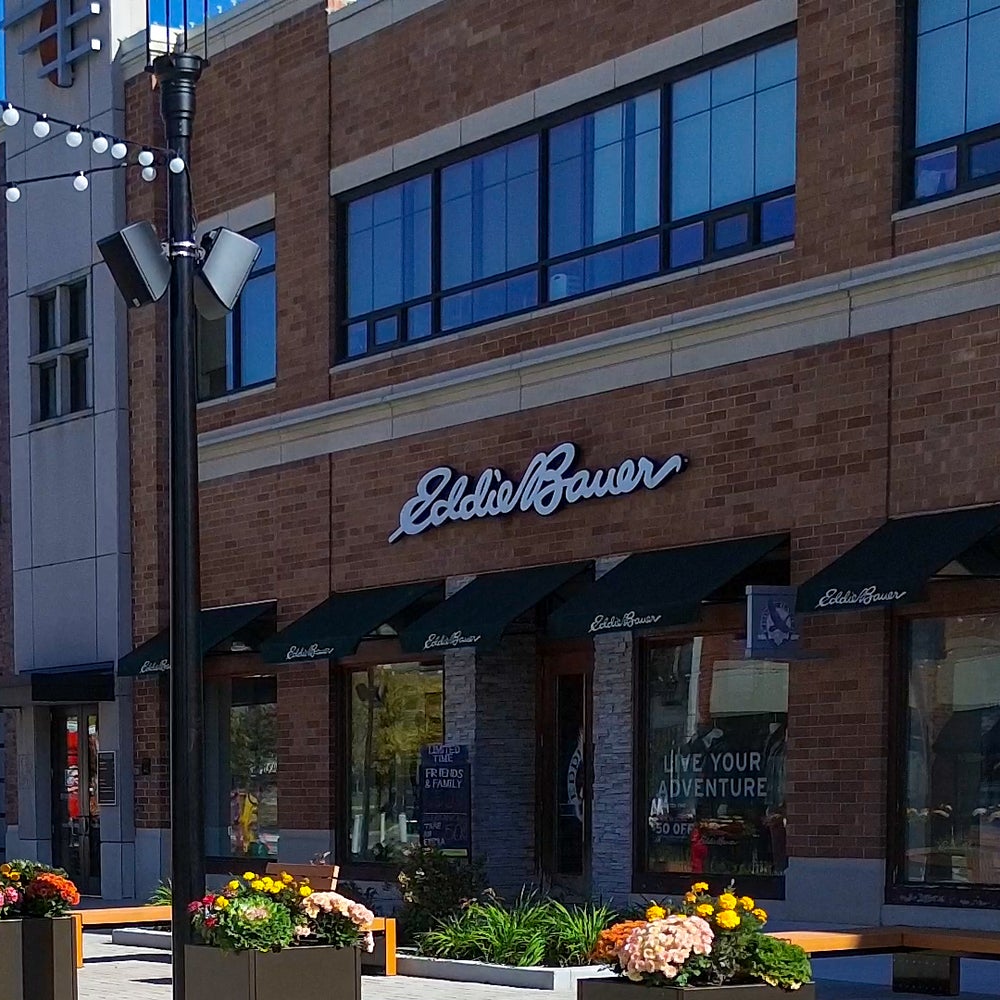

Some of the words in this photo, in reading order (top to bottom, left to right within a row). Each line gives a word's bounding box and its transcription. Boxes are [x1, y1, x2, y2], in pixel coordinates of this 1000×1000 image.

[388, 465, 521, 544] Eddie
[520, 442, 683, 516] Bauer
[815, 588, 858, 609] Eddie
[858, 585, 907, 606] Bauer
[588, 614, 622, 633] Eddie
[622, 611, 662, 628] Bauer
[663, 752, 703, 773] LIVE
[710, 751, 761, 772] YOUR
[424, 779, 431, 789] &
[432, 779, 462, 789] FAMILY
[425, 768, 464, 779] FRIENDS
[658, 777, 768, 799] ADVENTURE
